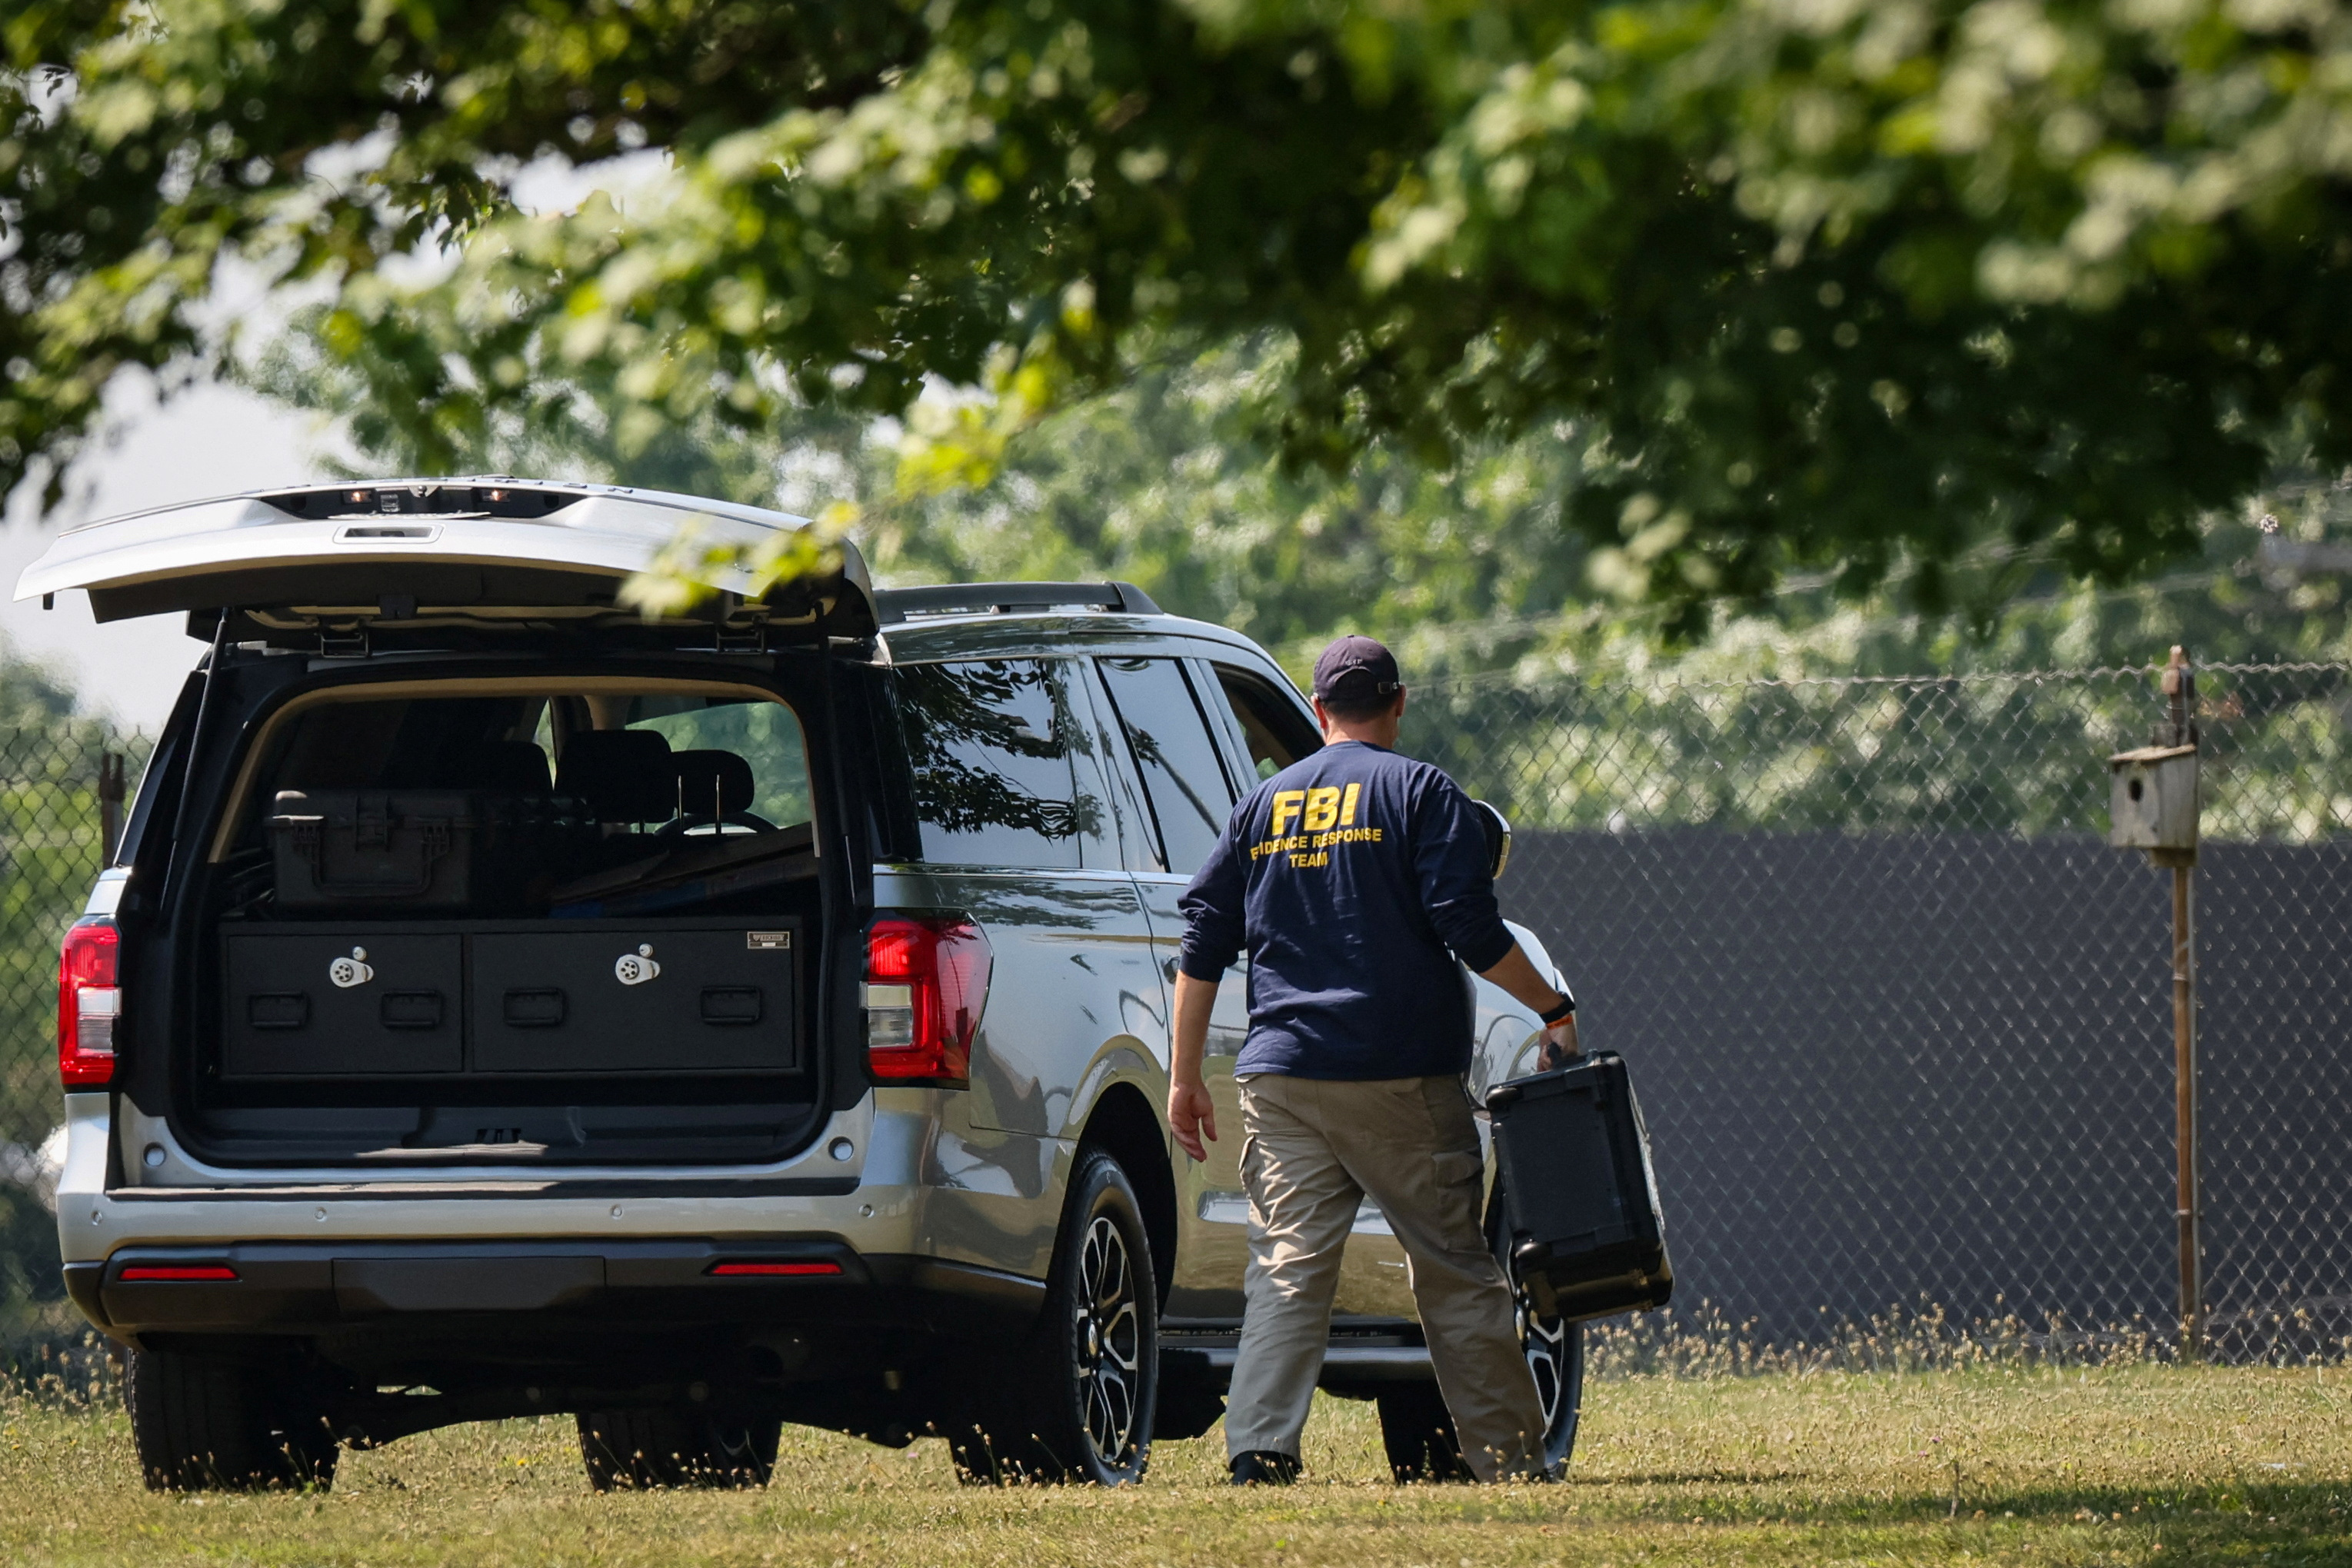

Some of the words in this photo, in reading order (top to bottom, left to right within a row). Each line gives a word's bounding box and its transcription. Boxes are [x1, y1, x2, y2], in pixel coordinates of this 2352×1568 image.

[1271, 783, 1361, 836] FBI
[1250, 836, 1308, 861] EIDENCE
[1312, 828, 1383, 849] RESPONSE
[1289, 852, 1328, 868] TEAM
